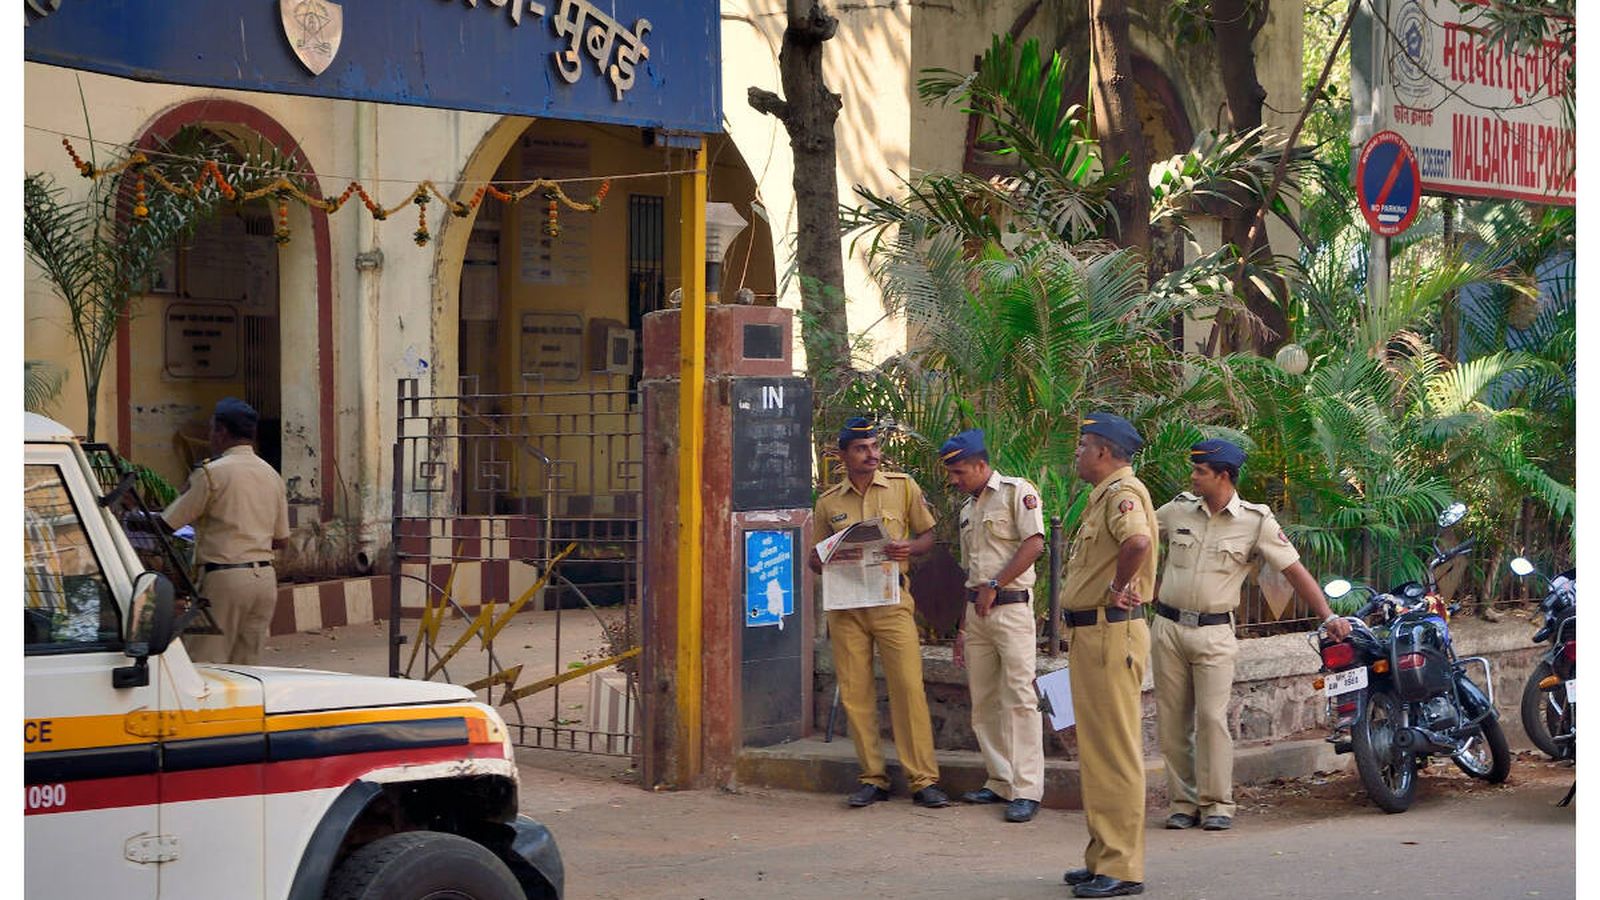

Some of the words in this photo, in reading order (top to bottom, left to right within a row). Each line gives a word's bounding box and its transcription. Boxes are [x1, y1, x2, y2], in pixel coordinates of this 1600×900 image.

[1452, 113, 1510, 185] MALBAR
[1511, 121, 1536, 188] HILL
[1381, 204, 1407, 214] PARKING
[762, 386, 784, 409] IN
[24, 721, 53, 743] CE
